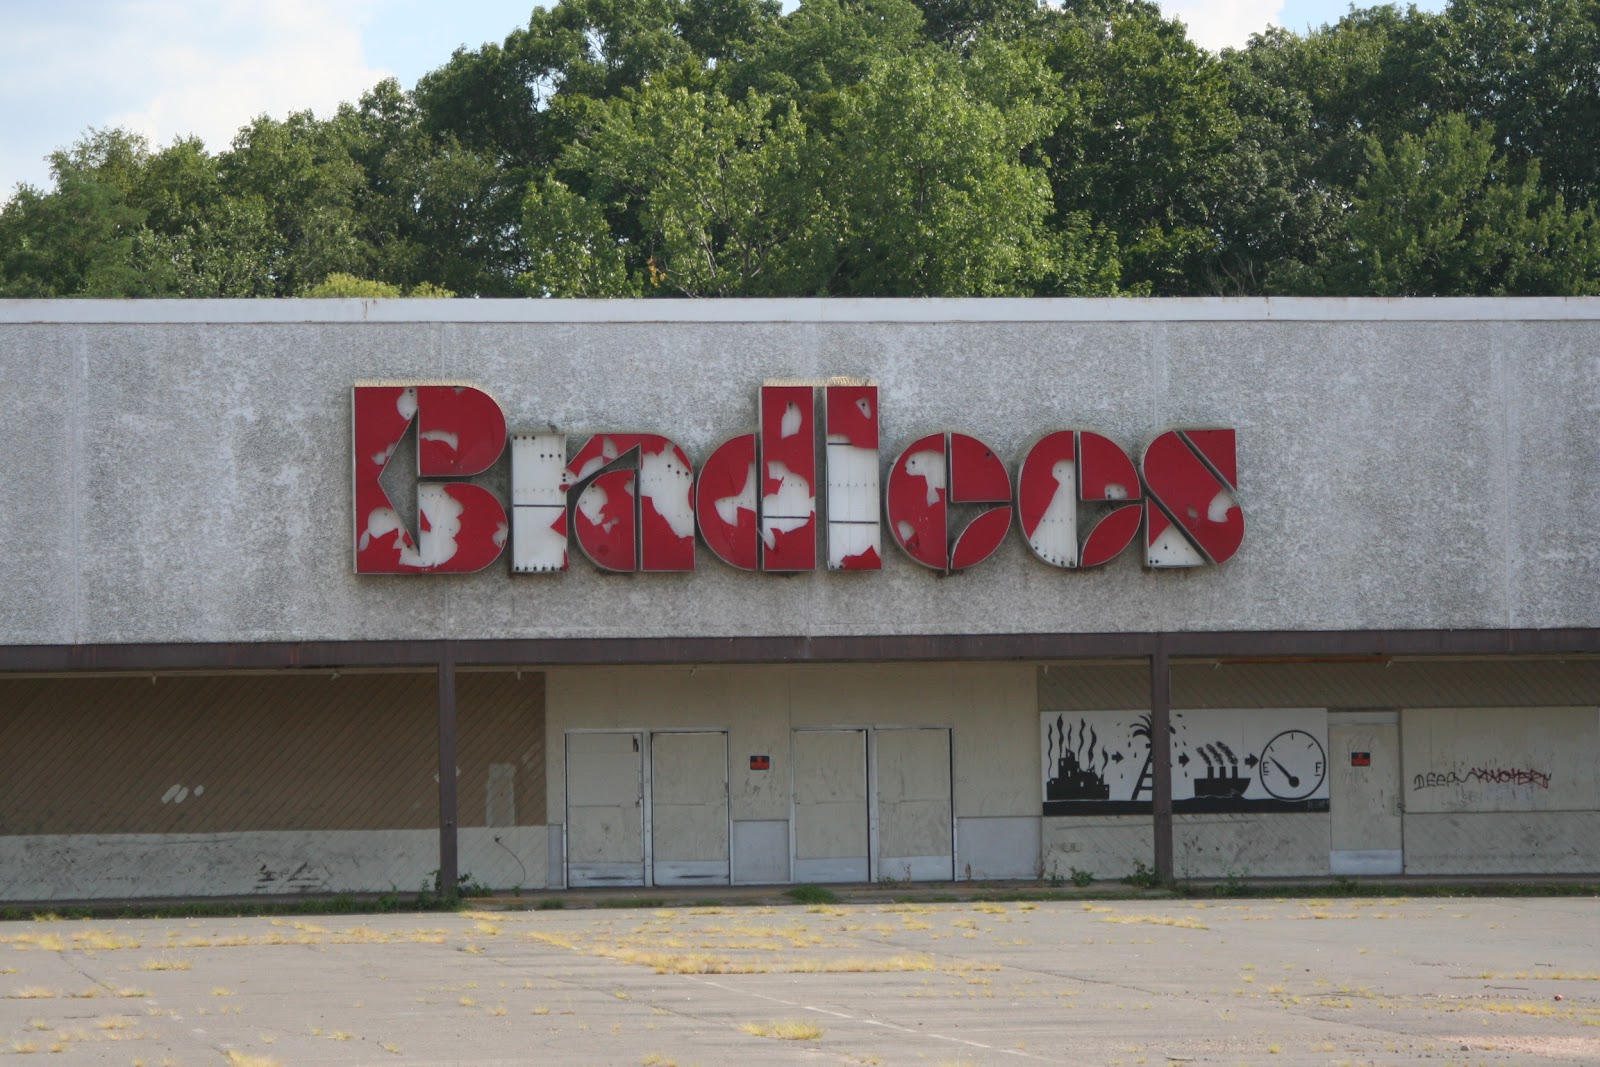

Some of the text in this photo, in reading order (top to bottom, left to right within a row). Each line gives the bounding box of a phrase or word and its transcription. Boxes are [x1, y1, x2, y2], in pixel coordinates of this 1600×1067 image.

[353, 386, 1245, 576] Bradlees
[1262, 761, 1270, 774] E
[1315, 761, 1322, 774] F
